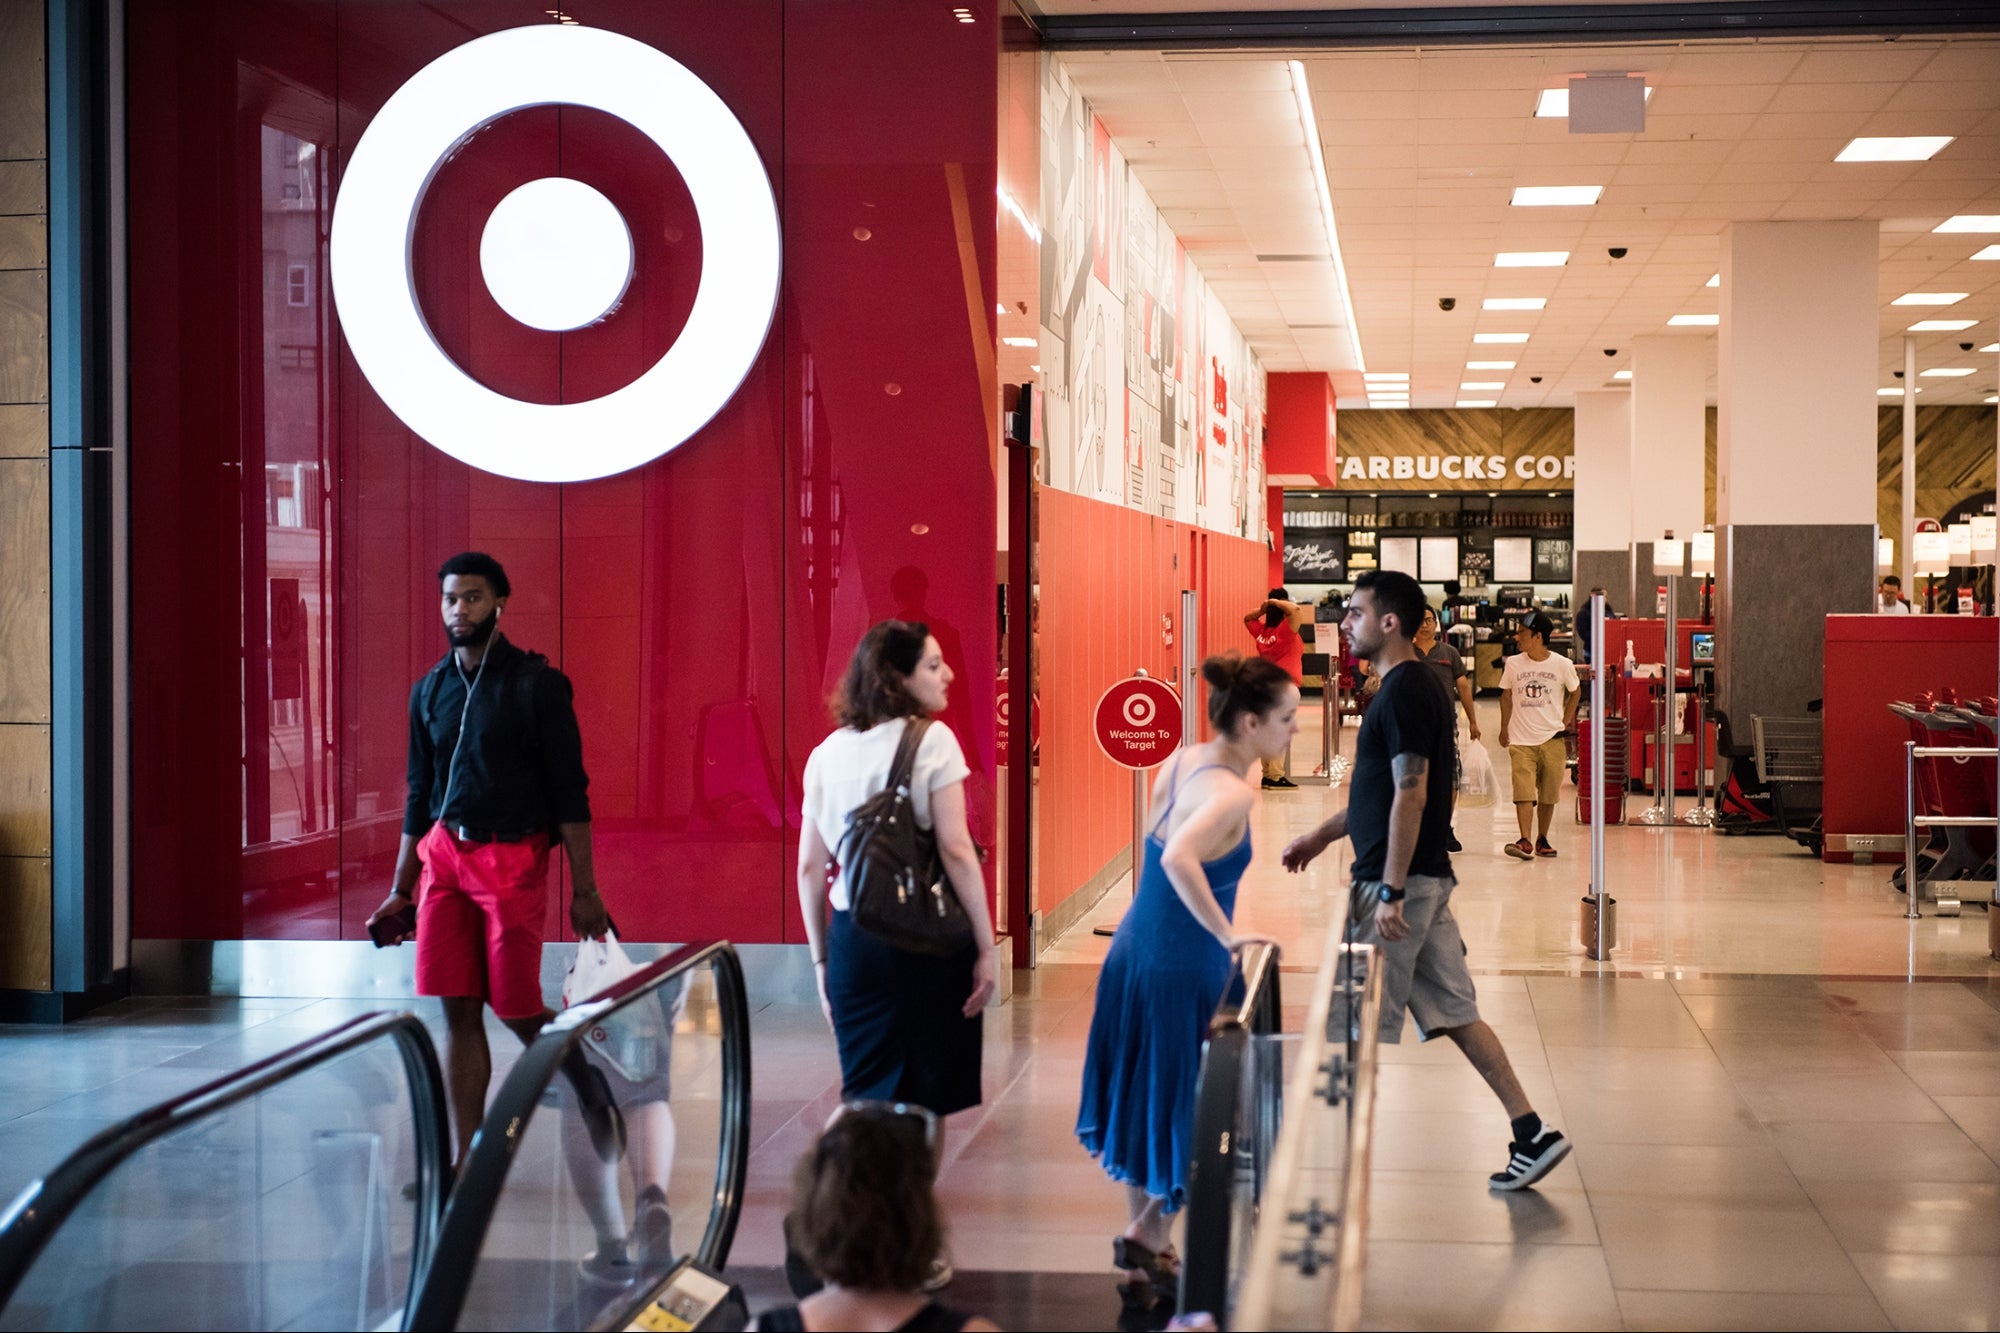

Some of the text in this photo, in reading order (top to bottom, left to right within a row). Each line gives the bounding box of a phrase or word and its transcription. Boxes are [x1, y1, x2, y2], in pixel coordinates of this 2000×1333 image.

[1109, 729, 1170, 739] Welcome To
[1124, 740, 1156, 751] Target
